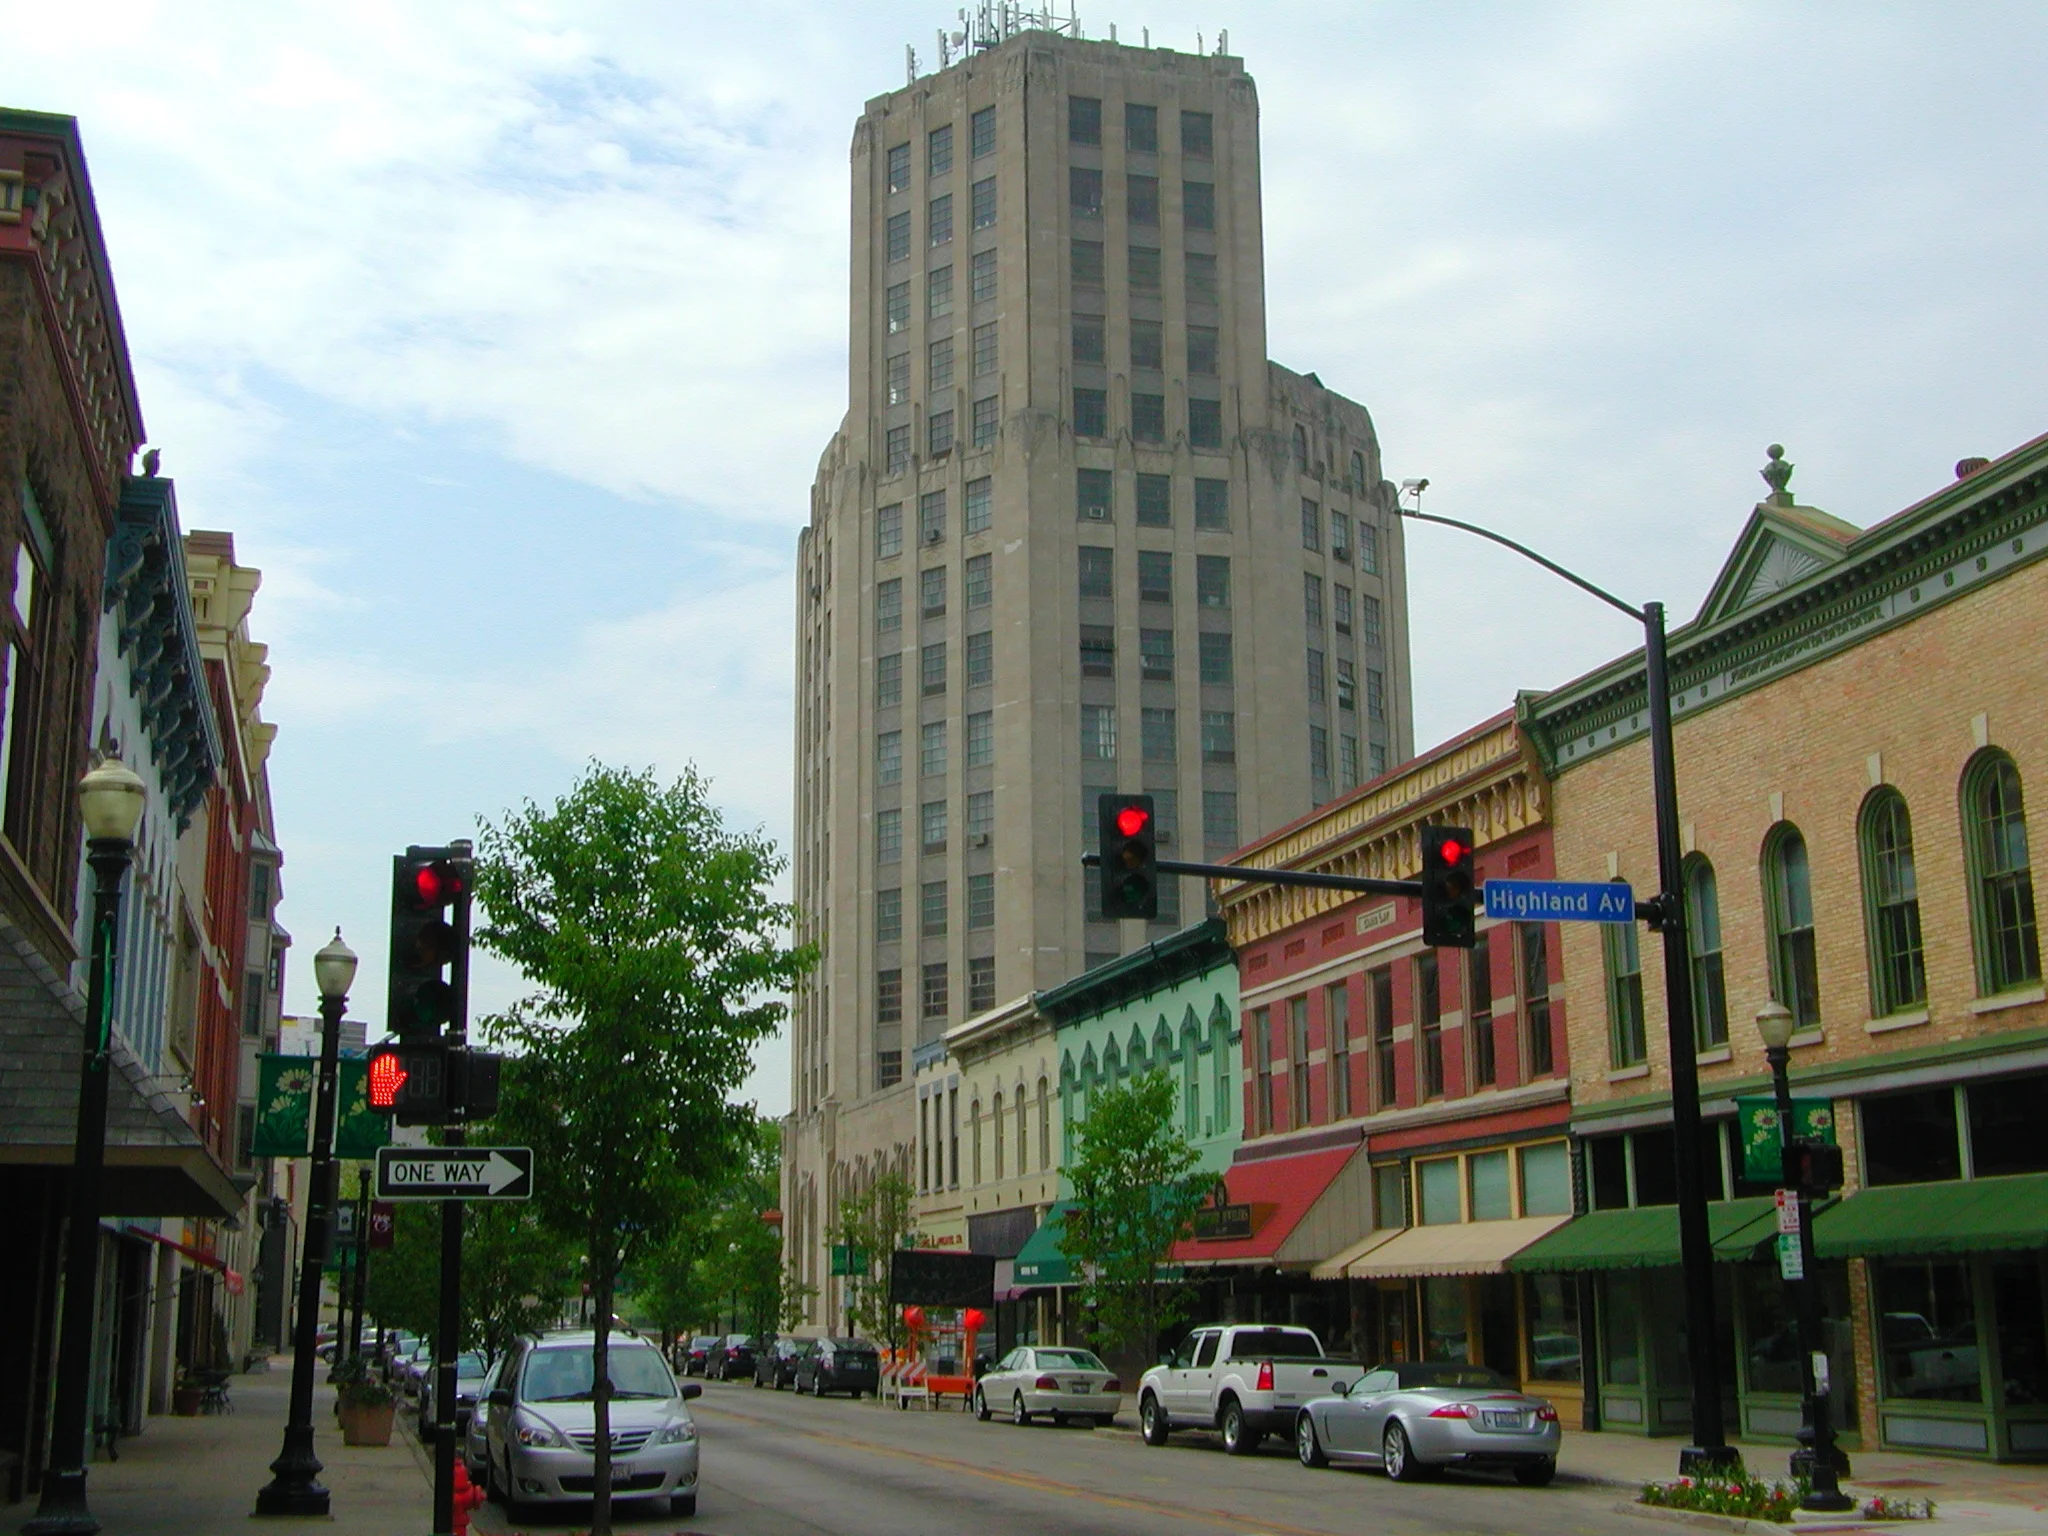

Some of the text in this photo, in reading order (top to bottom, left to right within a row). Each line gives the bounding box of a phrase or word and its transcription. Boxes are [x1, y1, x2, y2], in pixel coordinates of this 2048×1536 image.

[1491, 889, 1626, 917] Highland Av
[394, 1163, 486, 1182] ONE WAY
